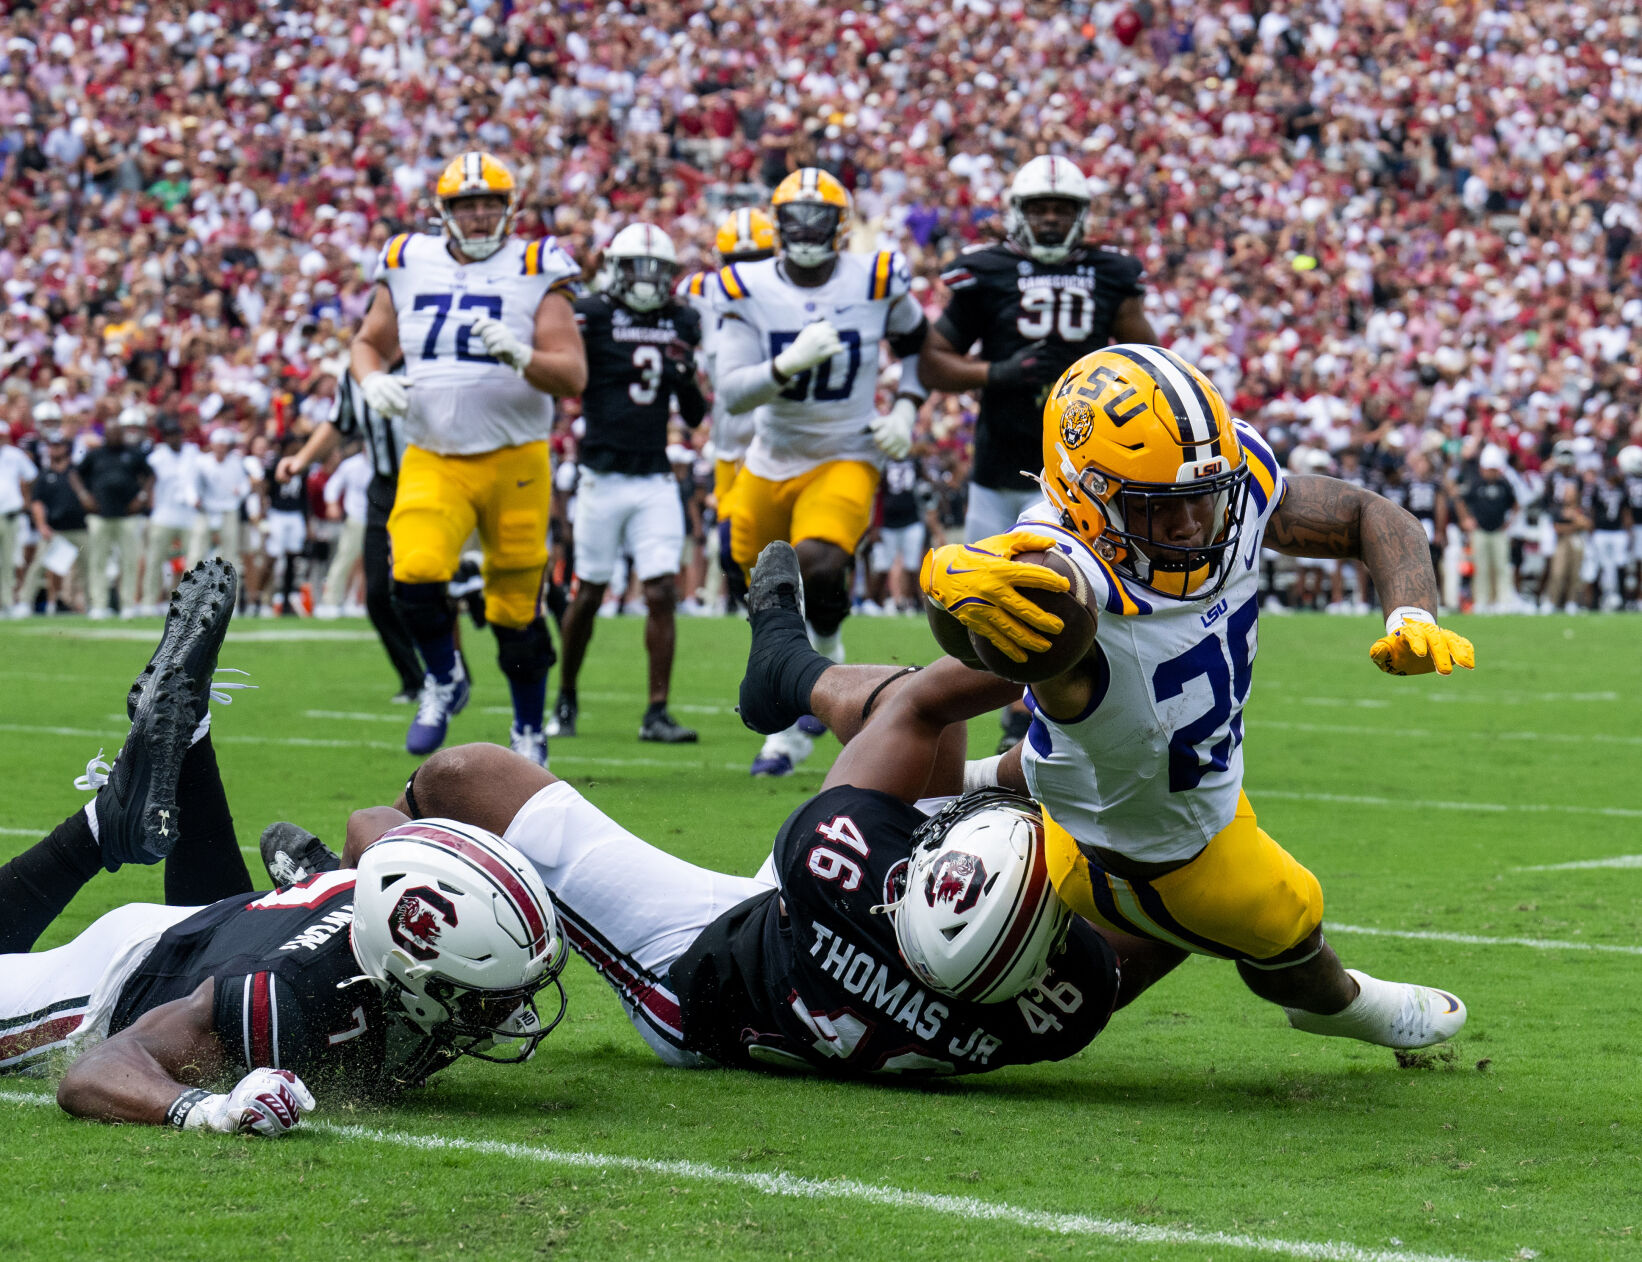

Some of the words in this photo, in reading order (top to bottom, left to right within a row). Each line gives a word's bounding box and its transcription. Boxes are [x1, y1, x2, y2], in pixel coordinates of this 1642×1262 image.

[413, 293, 503, 364] 72
[1017, 287, 1096, 342] 90
[628, 345, 664, 405] 3
[1193, 459, 1223, 479] LSU
[1200, 598, 1228, 629] LSU
[805, 815, 871, 892] 46
[809, 920, 949, 1041] THOMAS
[948, 1027, 1003, 1065] JR
[1016, 967, 1083, 1034] 46
[328, 1005, 368, 1046] 7
